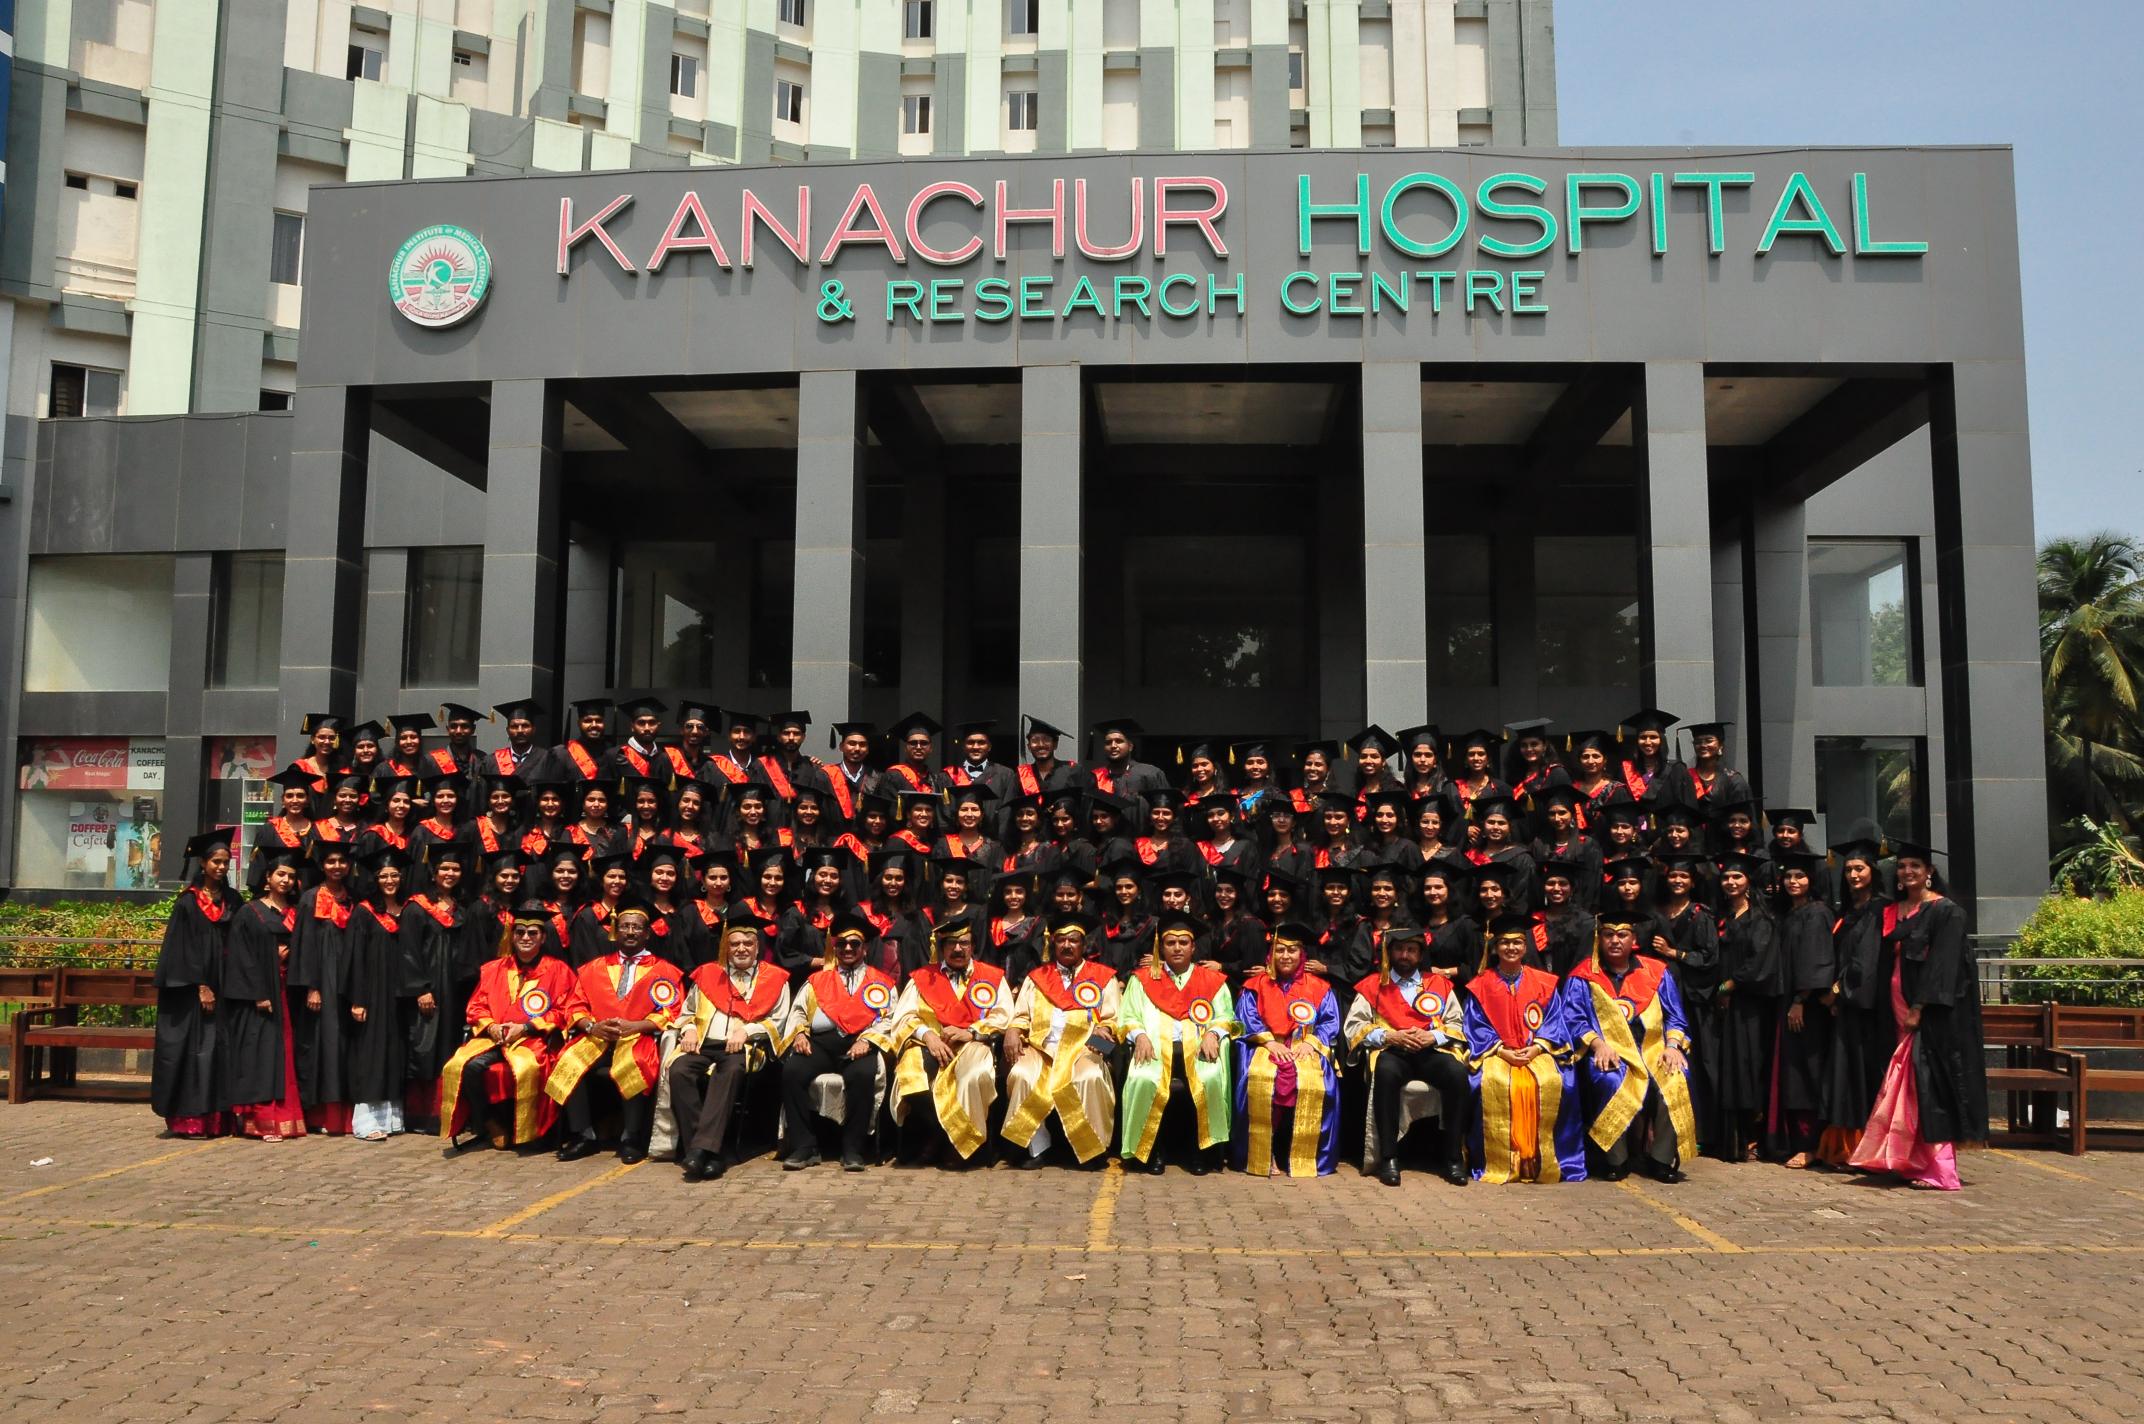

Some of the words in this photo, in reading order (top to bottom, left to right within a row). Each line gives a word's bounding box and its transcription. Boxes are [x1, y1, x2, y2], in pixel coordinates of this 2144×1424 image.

[556, 176, 1230, 276] KANACHUR
[1295, 171, 1930, 257] HOSPITAL
[405, 227, 443, 251] INSTITUTE
[454, 227, 482, 254] MEDICAL
[472, 254, 488, 295] SCIENCES
[815, 277, 856, 323] &
[885, 271, 1245, 322] RESEARCH
[1280, 269, 1549, 316] CENTRE
[136, 759, 166, 767] COFFEE
